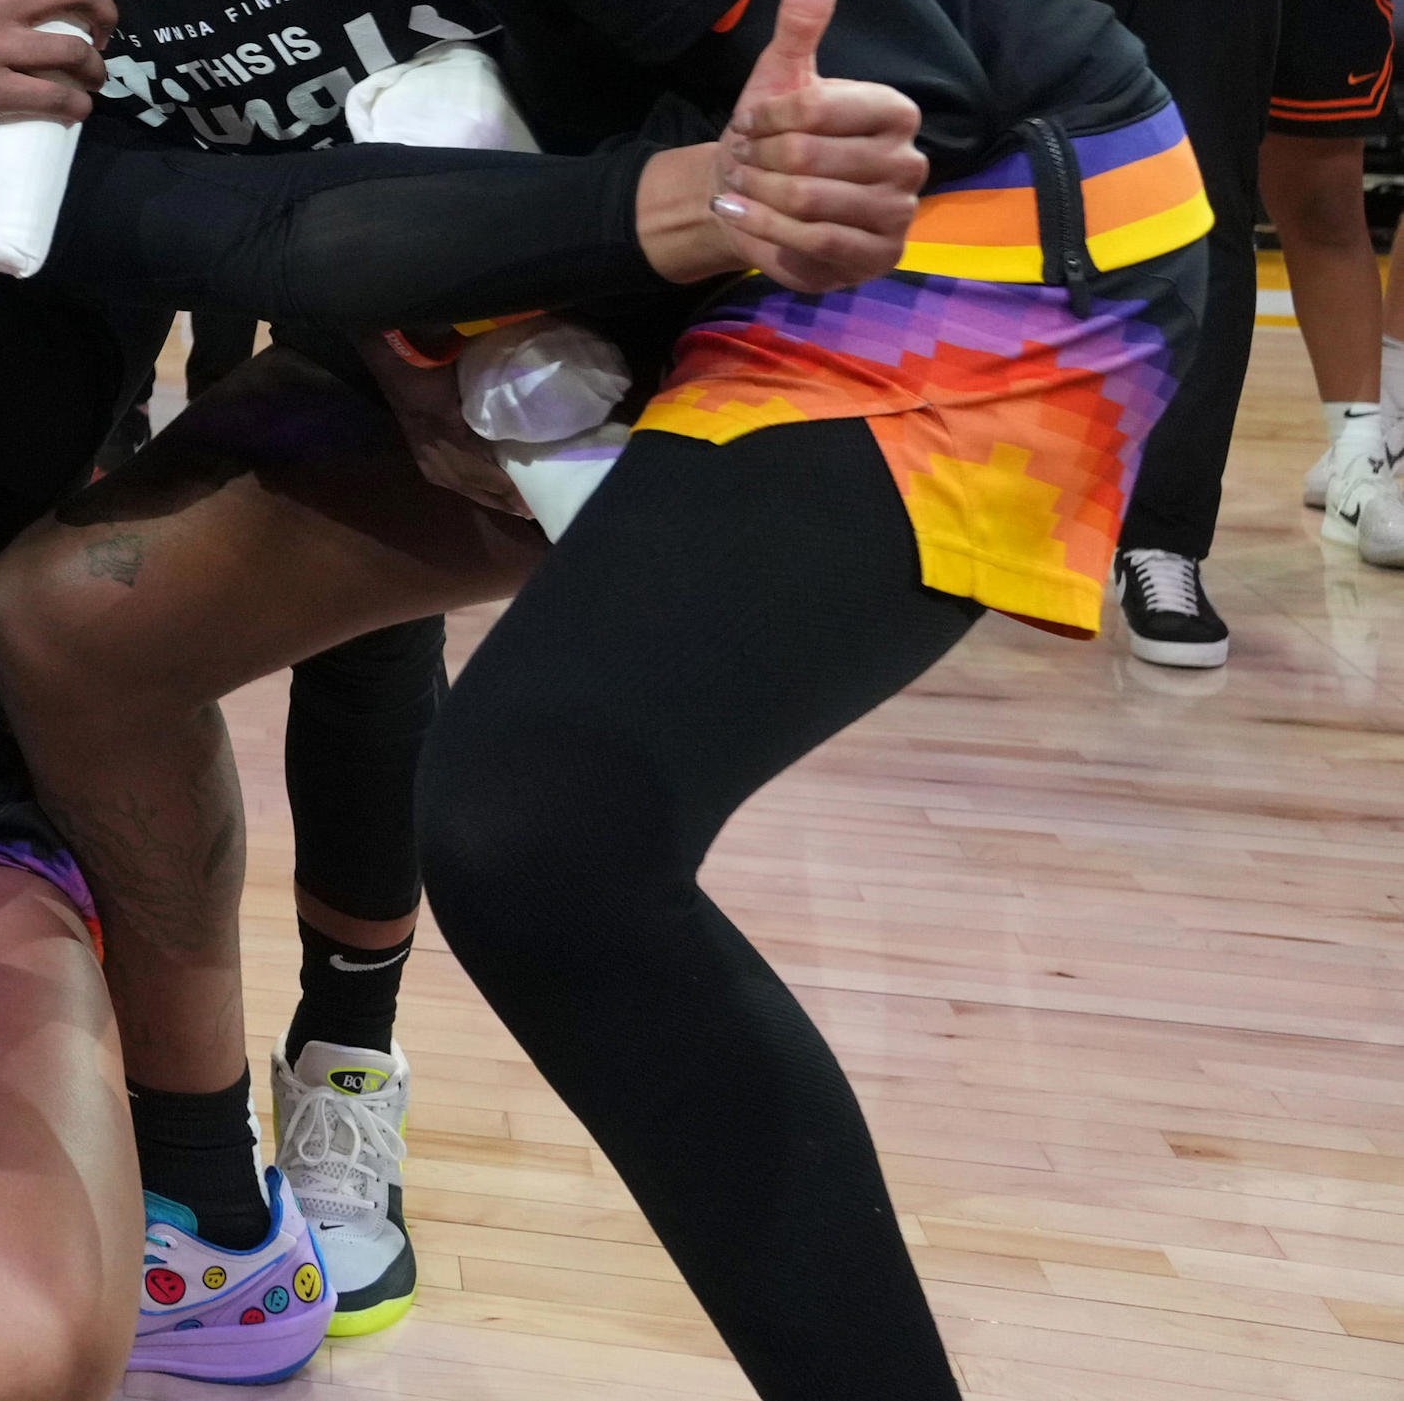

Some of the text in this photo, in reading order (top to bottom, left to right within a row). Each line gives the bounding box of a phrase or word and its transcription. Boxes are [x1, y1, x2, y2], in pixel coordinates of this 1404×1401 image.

[153, 20, 215, 44] WNBA
[175, 26, 323, 91] THIS IS
